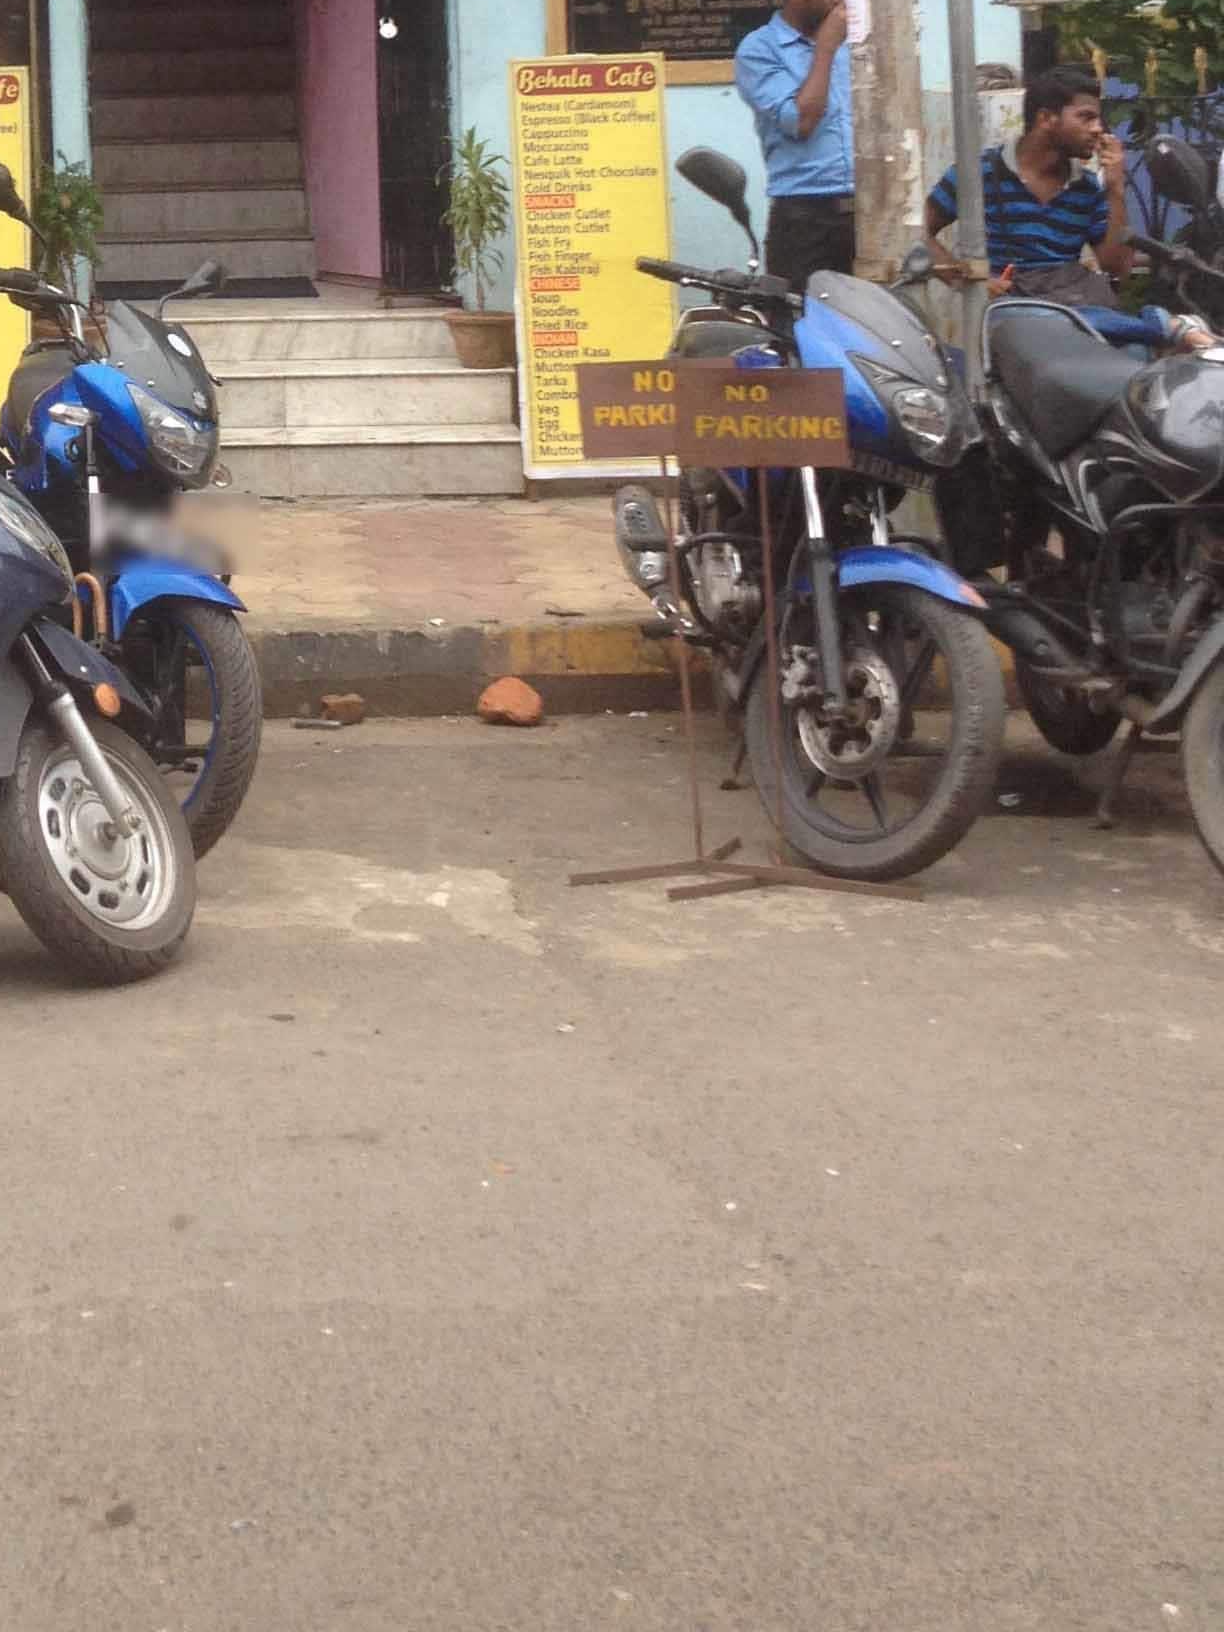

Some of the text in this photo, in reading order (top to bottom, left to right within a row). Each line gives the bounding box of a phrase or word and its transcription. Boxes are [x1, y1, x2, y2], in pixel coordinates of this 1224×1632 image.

[519, 66, 656, 92] Behala Cafe
[521, 115, 571, 126] Espresso
[524, 154, 582, 166] Cafe Latte
[575, 167, 596, 178] Hot
[600, 166, 657, 178] Chocolate
[525, 181, 592, 193] Cold Drinks
[526, 208, 611, 221] Chicken Cutlet
[527, 222, 611, 234] Mutton Cutlet
[527, 236, 571, 250] Fish Fry
[529, 250, 592, 264] Fish Finger
[530, 264, 552, 275] Fish
[531, 292, 561, 305] Soup
[532, 304, 580, 317] Noodles
[532, 318, 589, 330] Fried Rice
[534, 346, 611, 359] Chicken Kasa
[633, 369, 675, 393] NO
[725, 384, 769, 402] NO
[537, 403, 560, 417] Veg
[538, 417, 560, 432] Egg
[694, 415, 844, 440] PARKING
